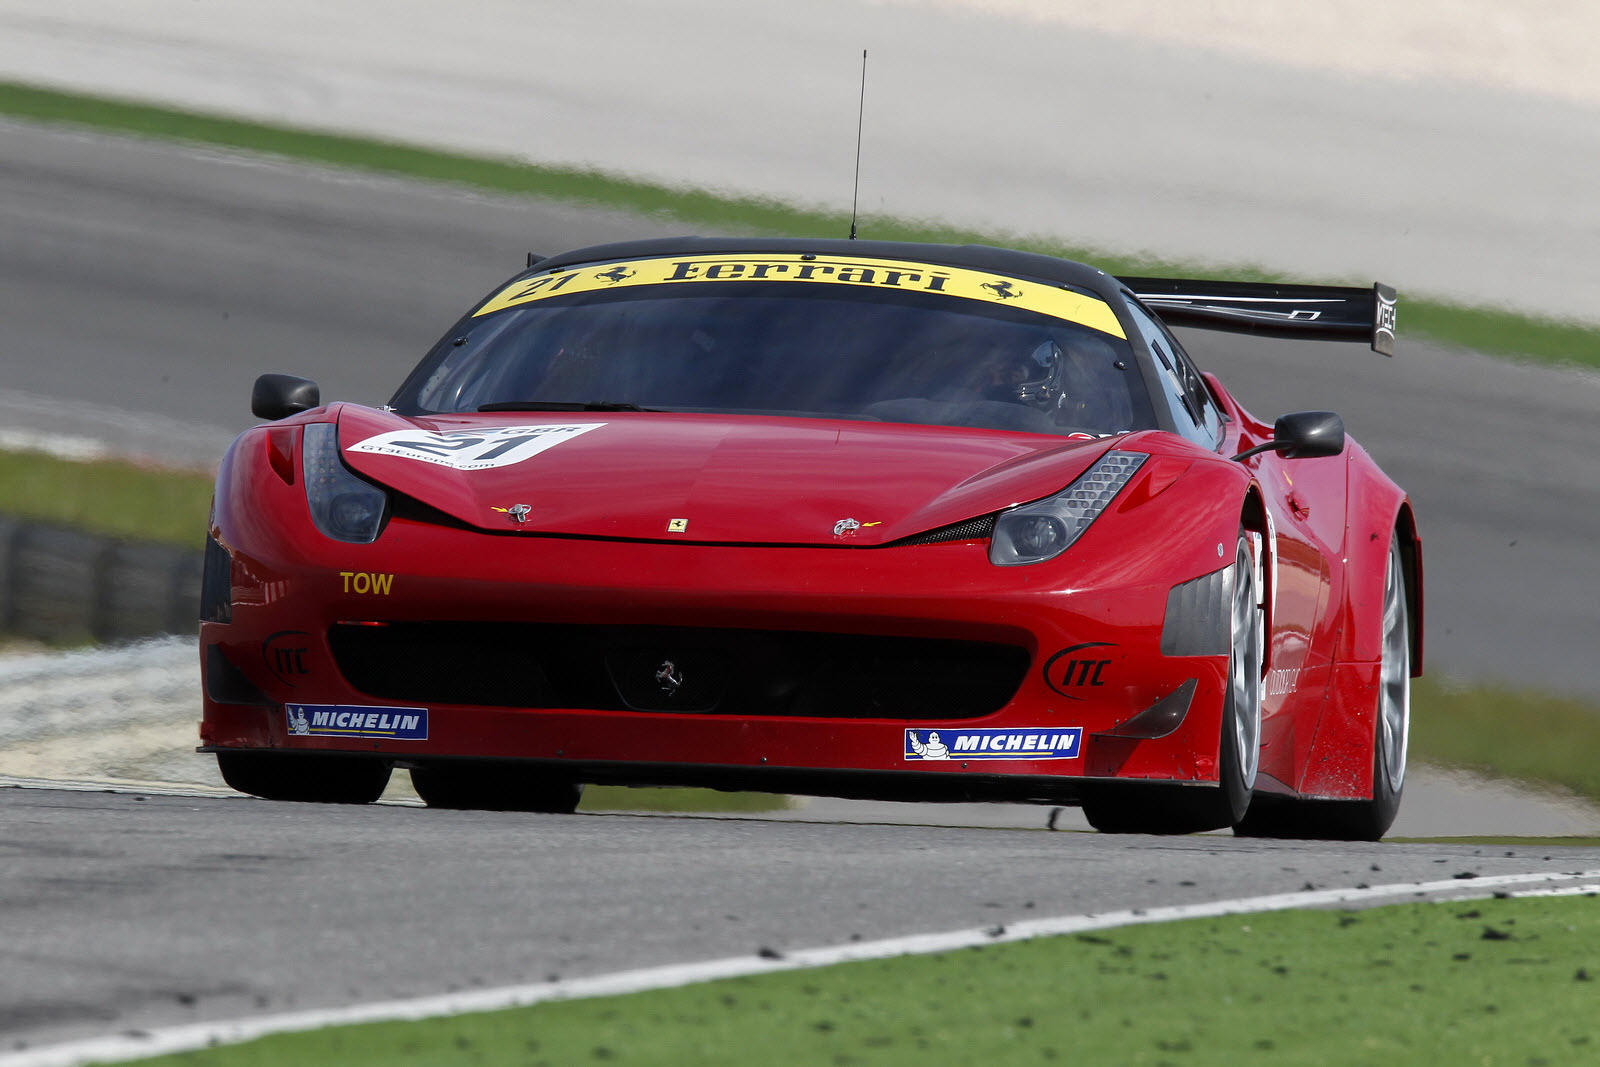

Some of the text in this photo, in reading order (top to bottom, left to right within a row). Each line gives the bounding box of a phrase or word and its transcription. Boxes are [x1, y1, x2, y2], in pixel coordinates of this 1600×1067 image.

[507, 259, 951, 301] 21 Ferrari
[500, 427, 582, 435] GBR
[360, 445, 495, 469] GT3Europe.com
[388, 435, 542, 460] 21
[340, 572, 394, 595] TOW
[1061, 660, 1112, 686] ITC
[312, 711, 420, 731] MICHELIN
[953, 734, 1075, 751] MICHELIN
